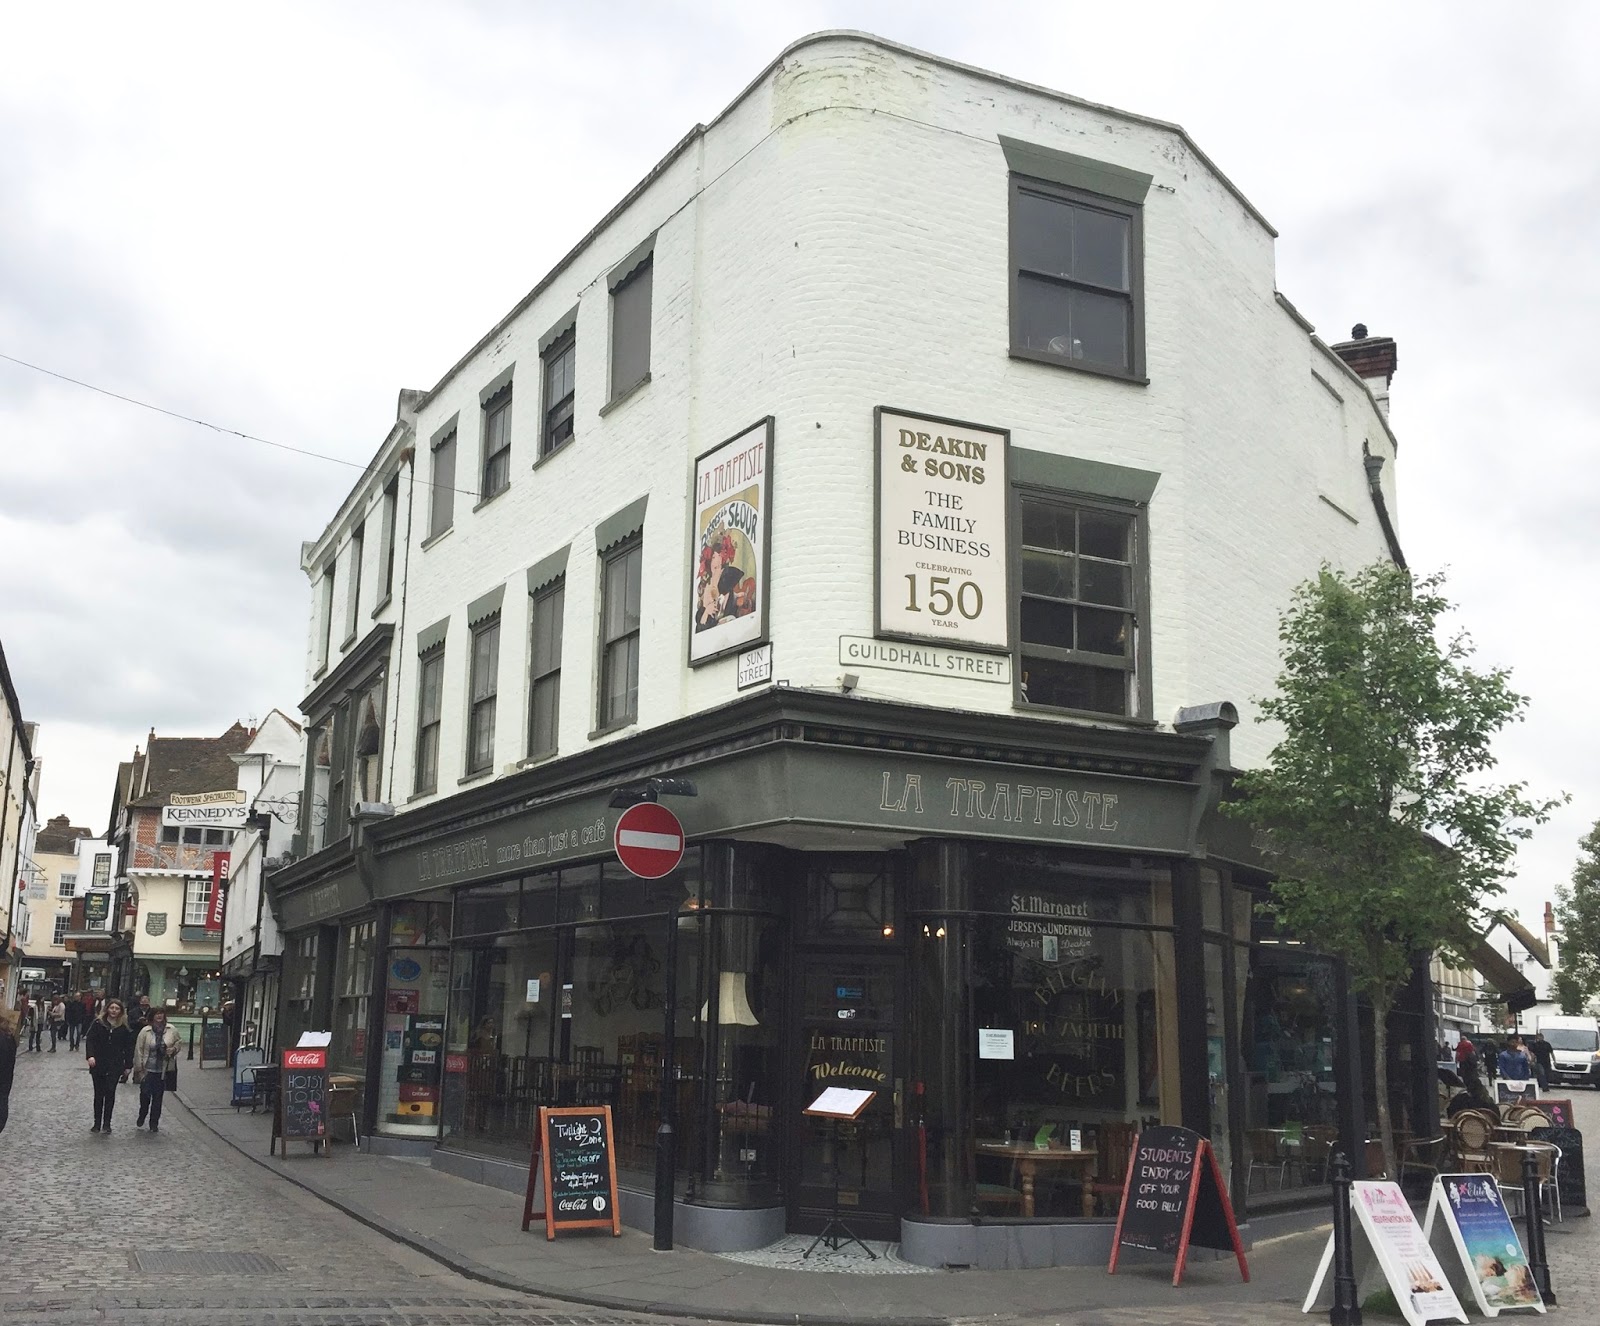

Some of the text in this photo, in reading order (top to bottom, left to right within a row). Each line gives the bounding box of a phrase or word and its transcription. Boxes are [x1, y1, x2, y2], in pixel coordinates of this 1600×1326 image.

[899, 429, 987, 461] DEAKIN
[698, 443, 764, 506] LA TRAPPISTE
[901, 454, 985, 484] & SONS
[924, 490, 963, 510] THE
[912, 511, 977, 534] FAMILY
[898, 530, 990, 558] BUSINESS
[915, 562, 972, 576] CELEBRATING
[904, 573, 983, 620] 150
[931, 618, 958, 629] YEARS
[746, 650, 764, 667] SUN
[848, 643, 1004, 676] GUILDHALL STREET
[739, 663, 770, 684] STREET
[880, 772, 1118, 831] LA TRAPPISTE
[167, 807, 247, 822] KENNEDY'S
[496, 843, 521, 864] more
[523, 836, 547, 858] than
[547, 829, 569, 857] just
[571, 830, 579, 848] a
[581, 817, 606, 845] café
[1008, 920, 1042, 934] JERSEYS
[1047, 923, 1092, 938] UNDERWEAR
[811, 1036, 886, 1053] LA TRAPPISTE
[810, 1061, 887, 1082] Welcome
[555, 1122, 588, 1140] Twilight
[579, 1134, 602, 1147] Zone
[1139, 1147, 1192, 1164] STUDENTS
[1141, 1166, 1173, 1180] ENJOY
[1139, 1184, 1181, 1194] OFF YOUR
[1136, 1199, 1158, 1210] FOOD
